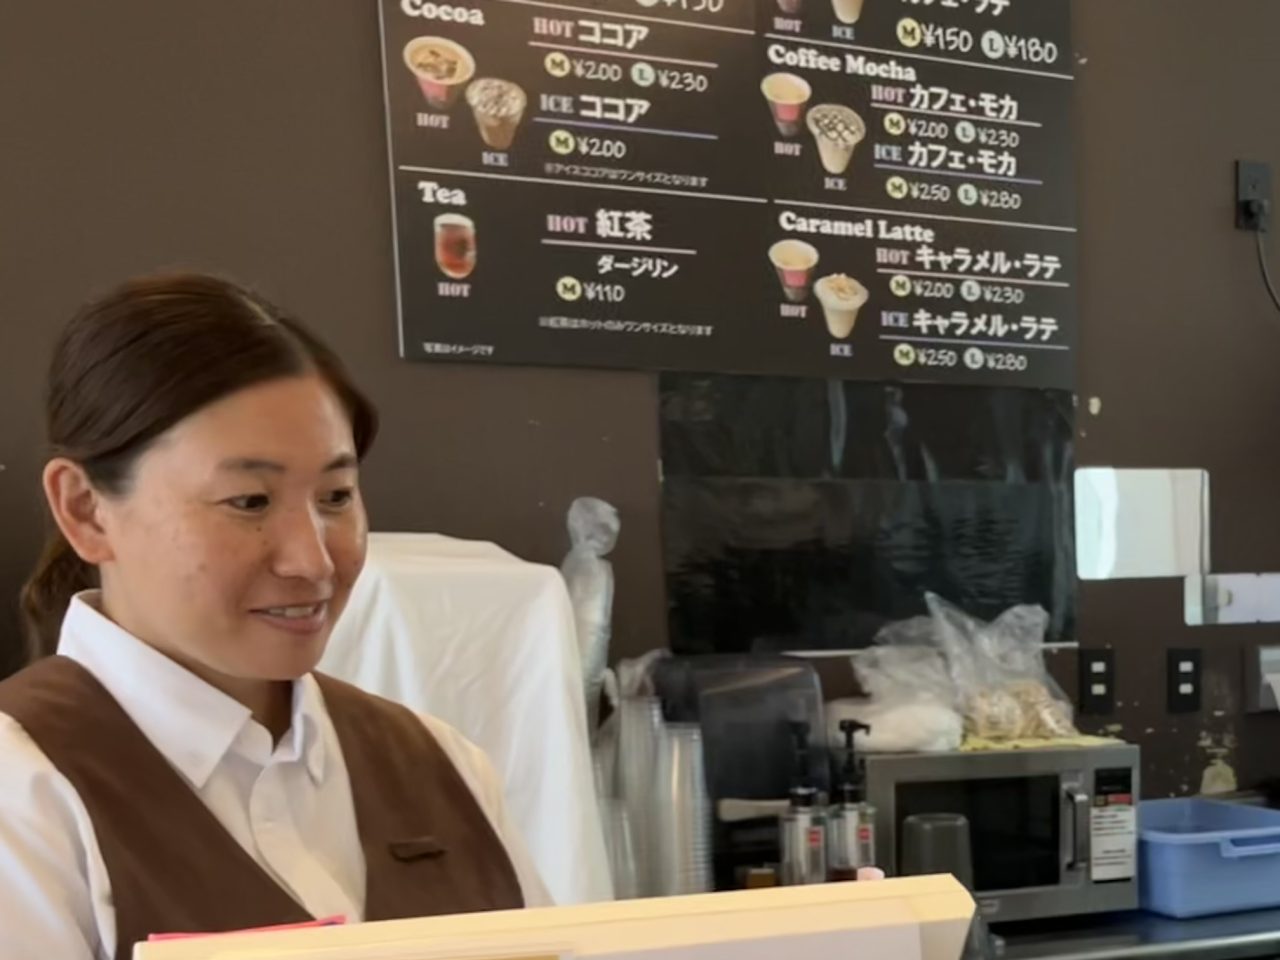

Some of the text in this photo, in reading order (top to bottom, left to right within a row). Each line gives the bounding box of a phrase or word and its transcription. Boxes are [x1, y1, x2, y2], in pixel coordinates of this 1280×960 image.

[400, 0, 485, 26] Cocoa
[533, 17, 649, 49] HOT ココア
[767, 44, 917, 82] Coffee Mocha
[540, 94, 650, 123] ICE ココア
[871, 84, 1019, 121] HOT カフェ・モカ
[416, 113, 449, 129] HOT
[874, 141, 1017, 178] ICE カフェ・モカ
[417, 181, 467, 205] Tea
[547, 208, 652, 241] HOT 紅茶
[778, 211, 935, 243] Caramel Latte
[597, 255, 679, 278] ダージリン
[915, 244, 1061, 280] キャラメル・ラテ
[437, 282, 471, 297] HOT
[881, 308, 1059, 342] ICE キャラメル・ラテ
